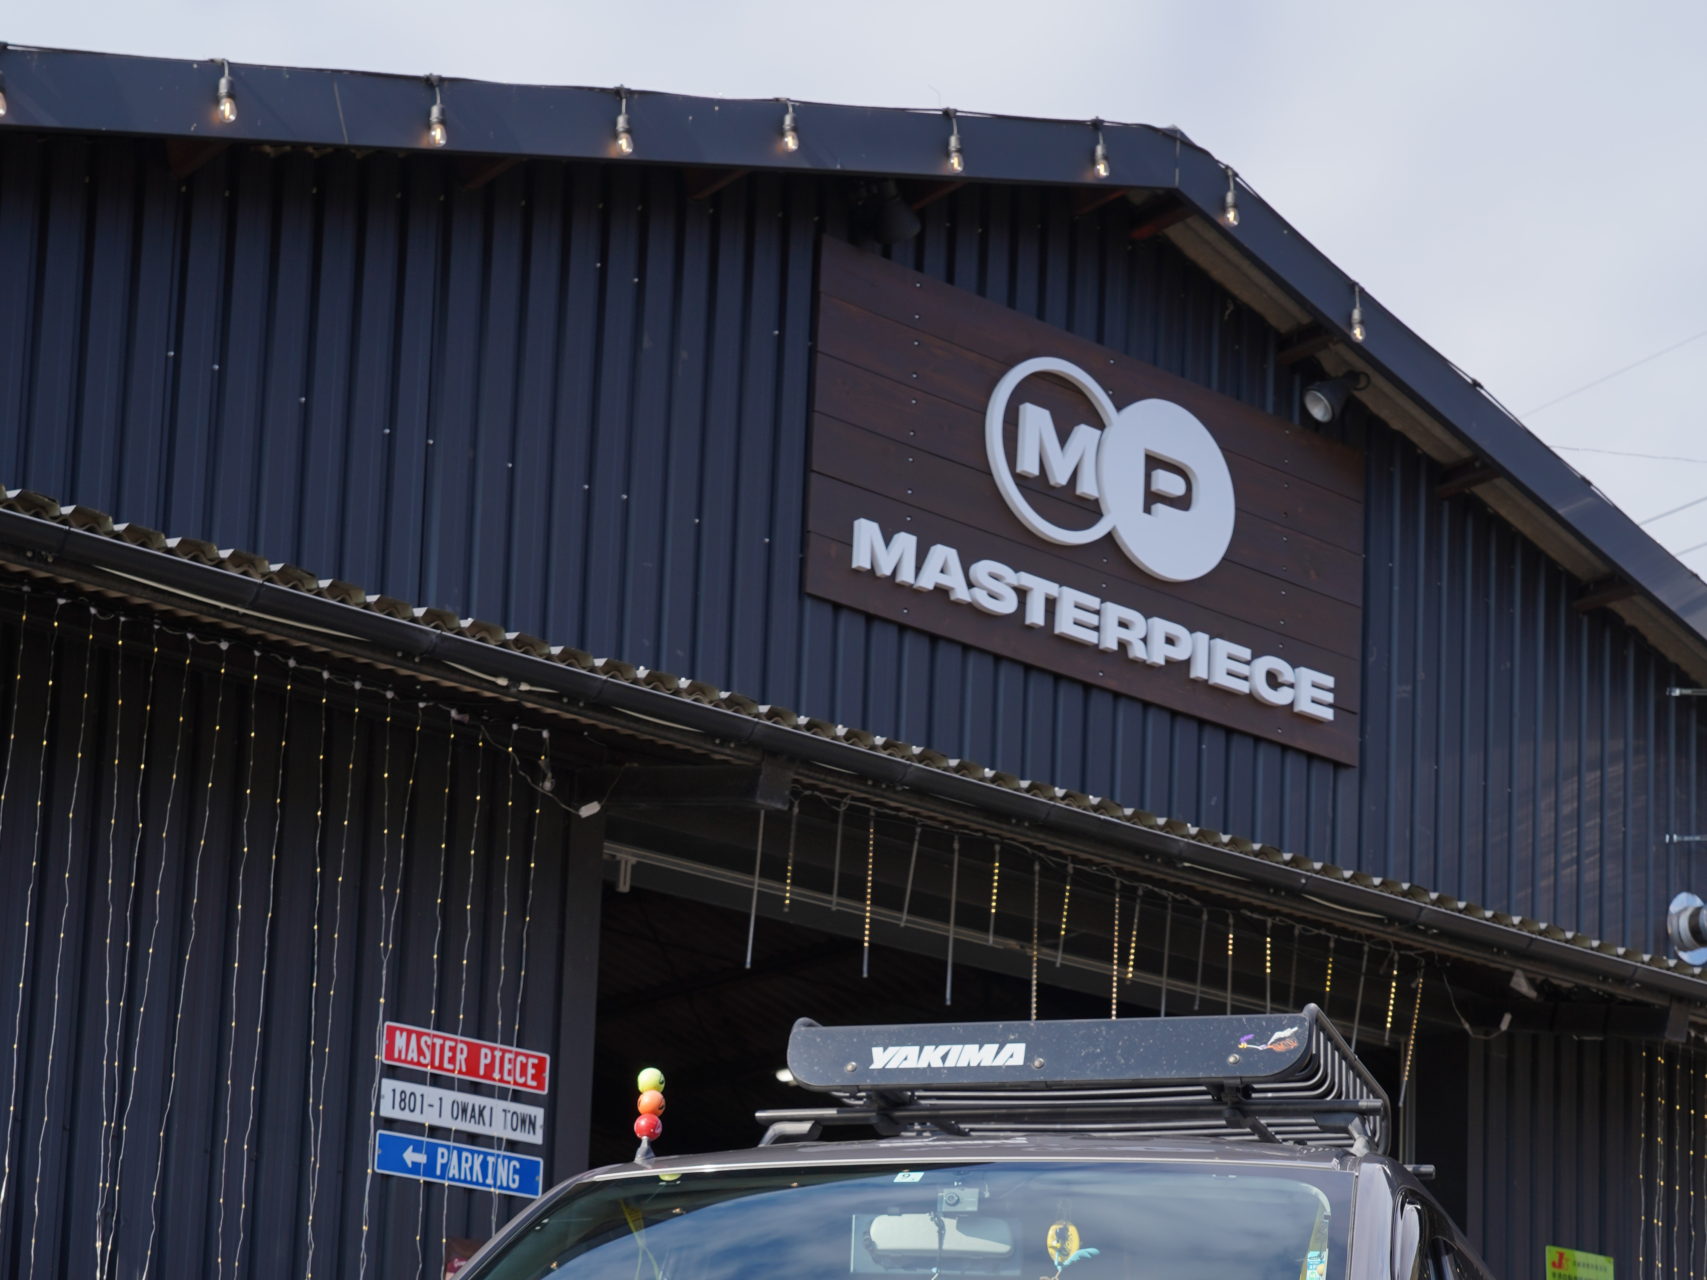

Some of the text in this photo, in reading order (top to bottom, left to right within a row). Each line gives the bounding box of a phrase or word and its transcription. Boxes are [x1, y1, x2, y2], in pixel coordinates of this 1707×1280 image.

[851, 517, 1335, 723] MASTERPIECE
[394, 1030, 539, 1087] MASTER PIECE
[868, 1042, 1027, 1070] YAKIMA
[391, 1088, 537, 1136] 1801-1 OWAKI TOWN
[436, 1147, 521, 1190] PARKING
